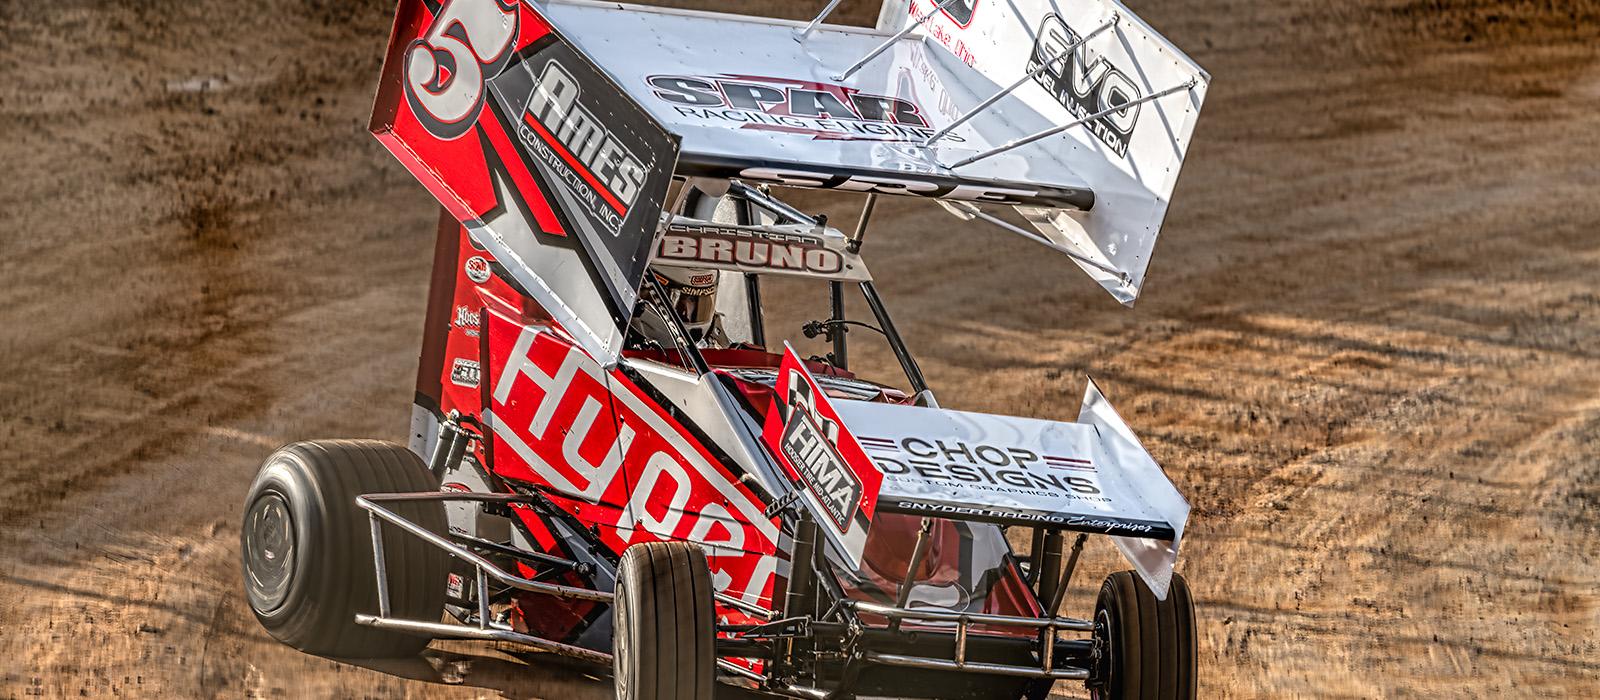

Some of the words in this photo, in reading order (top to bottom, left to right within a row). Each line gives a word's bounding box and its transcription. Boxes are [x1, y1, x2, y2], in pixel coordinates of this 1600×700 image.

[1038, 14, 1139, 133] EVO
[648, 76, 929, 128] SPAR
[529, 64, 643, 206] AMES
[673, 106, 806, 128] RACING
[814, 119, 966, 143] ENGINES
[520, 125, 597, 209] CONSTRUCTION,
[669, 225, 818, 245] CHRISTIAN
[660, 236, 842, 273] BRUNO
[491, 326, 780, 618] Hyper
[788, 421, 853, 517] HIMA
[901, 437, 1039, 469] CHOP
[872, 456, 1100, 494] DESIGNS
[887, 475, 964, 488] CUSTOM
[970, 484, 1060, 498] GRAPHICS
[898, 501, 984, 514] SNYDER
[991, 510, 1064, 523] RACING
